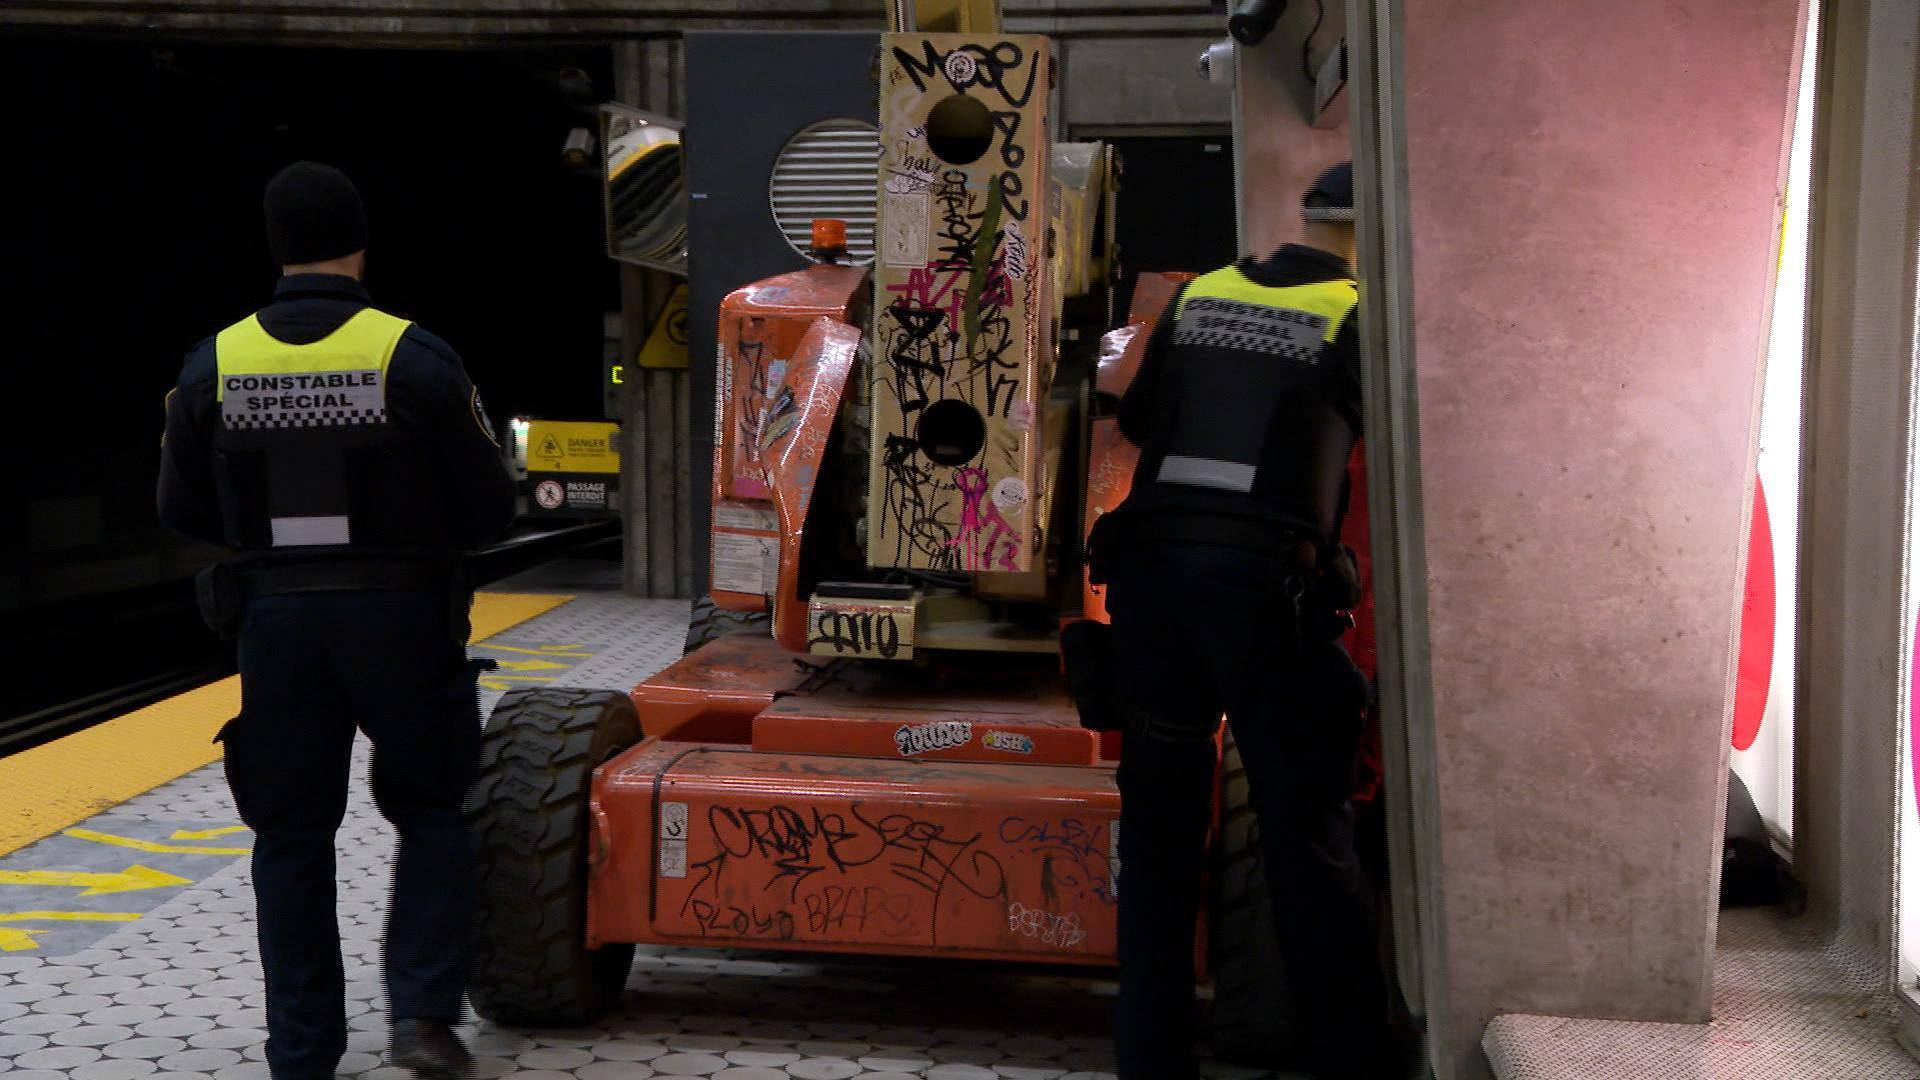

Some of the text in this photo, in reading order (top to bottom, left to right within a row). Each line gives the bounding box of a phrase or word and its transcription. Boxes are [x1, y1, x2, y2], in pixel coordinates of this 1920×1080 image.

[1185, 299, 1322, 328] CONSTABLE
[226, 372, 377, 391] CONSTABLE
[248, 392, 353, 411] SPÉCIAL
